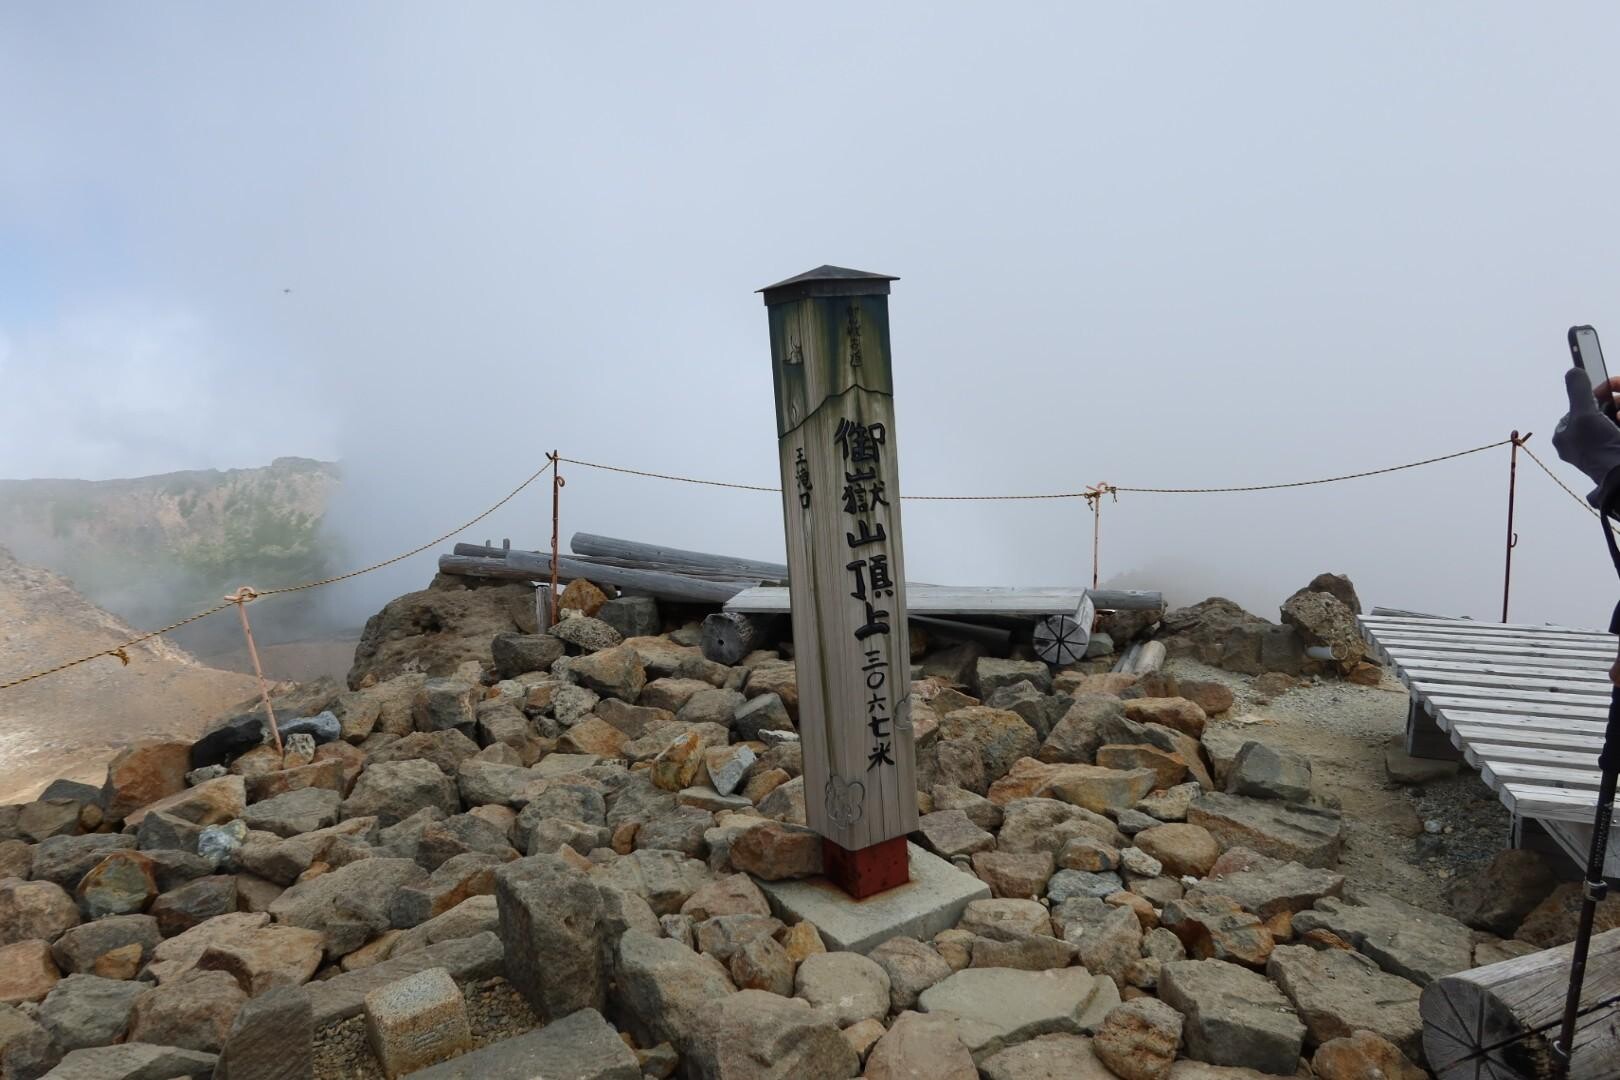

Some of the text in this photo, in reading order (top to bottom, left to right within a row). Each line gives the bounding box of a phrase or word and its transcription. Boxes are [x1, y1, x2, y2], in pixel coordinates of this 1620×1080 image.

[834, 417, 893, 641] 御嶽山頂上
